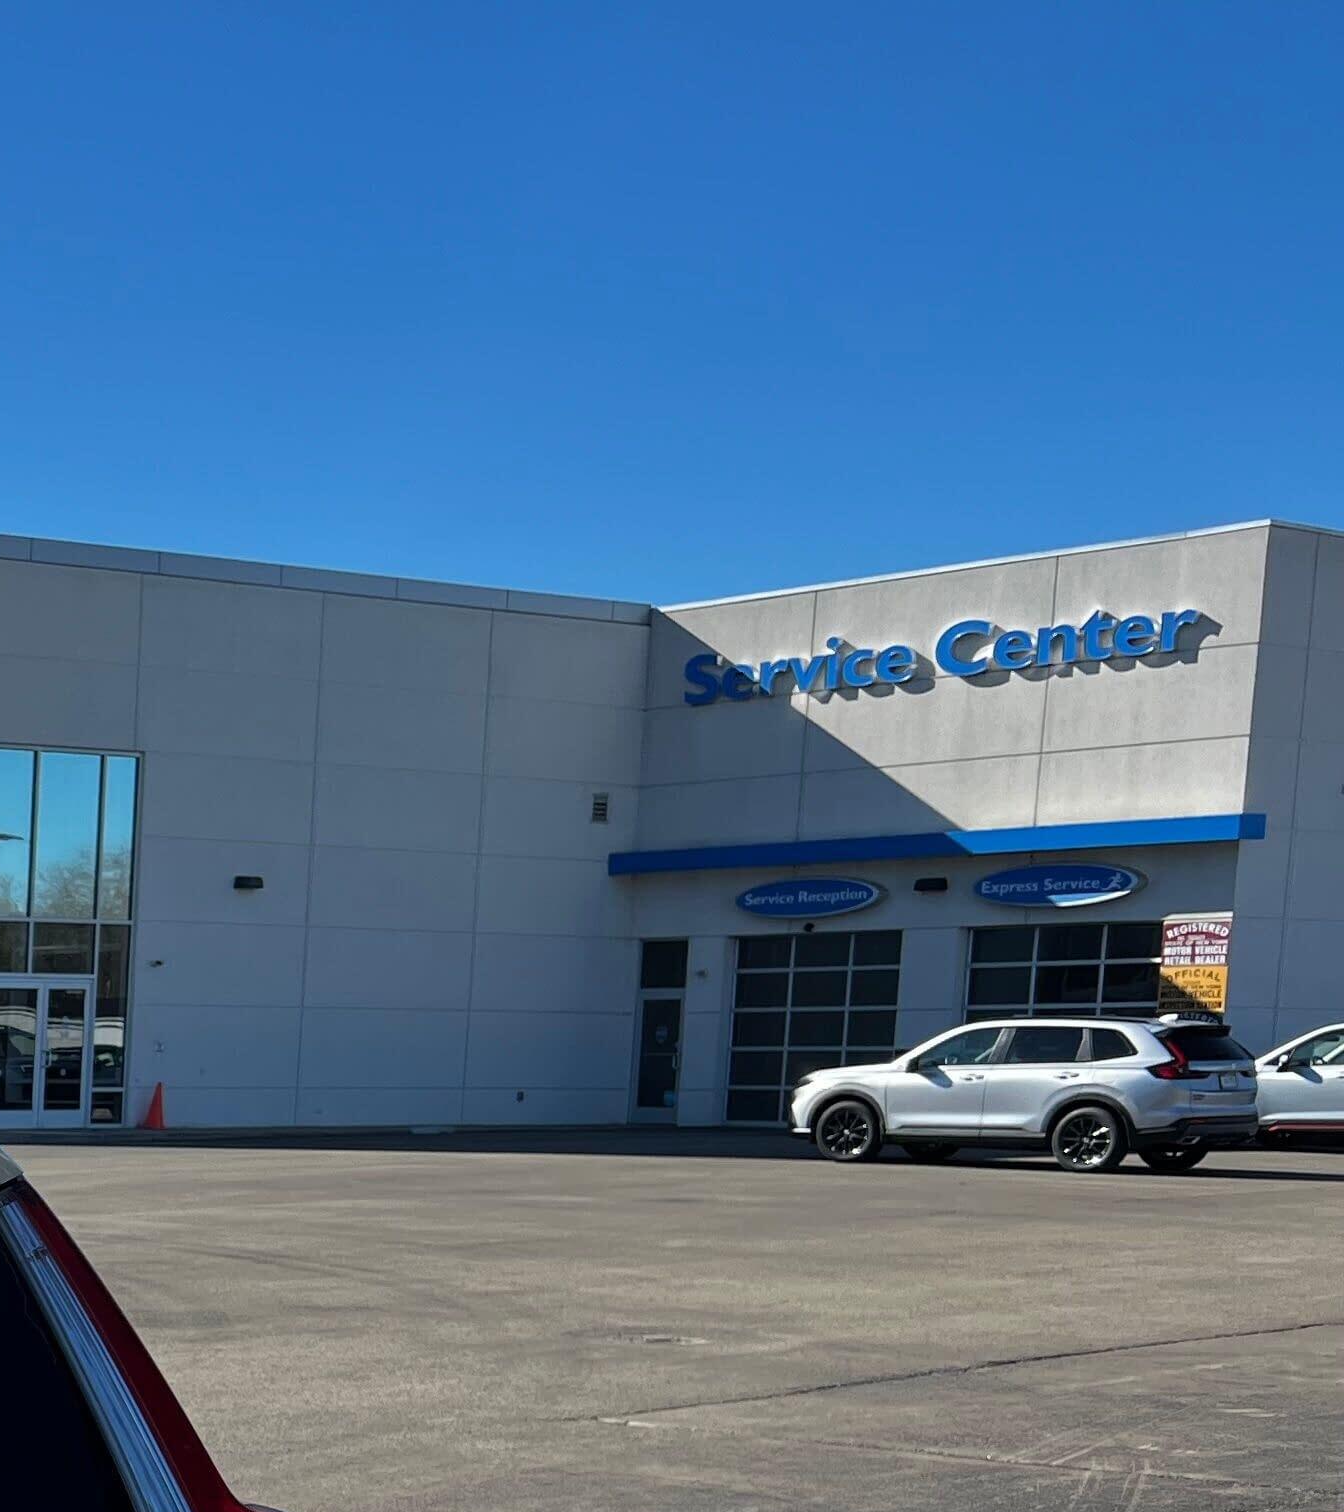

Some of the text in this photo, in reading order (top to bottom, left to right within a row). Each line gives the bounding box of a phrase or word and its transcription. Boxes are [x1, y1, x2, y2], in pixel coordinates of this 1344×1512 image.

[683, 607, 1199, 706] Service Center
[981, 877, 1101, 897] Express Service
[744, 887, 867, 906] Service Reception
[1166, 922, 1230, 939] REGISTERED
[1195, 945, 1228, 955] VEHICLE
[1164, 969, 1221, 983] OFFICIAL
